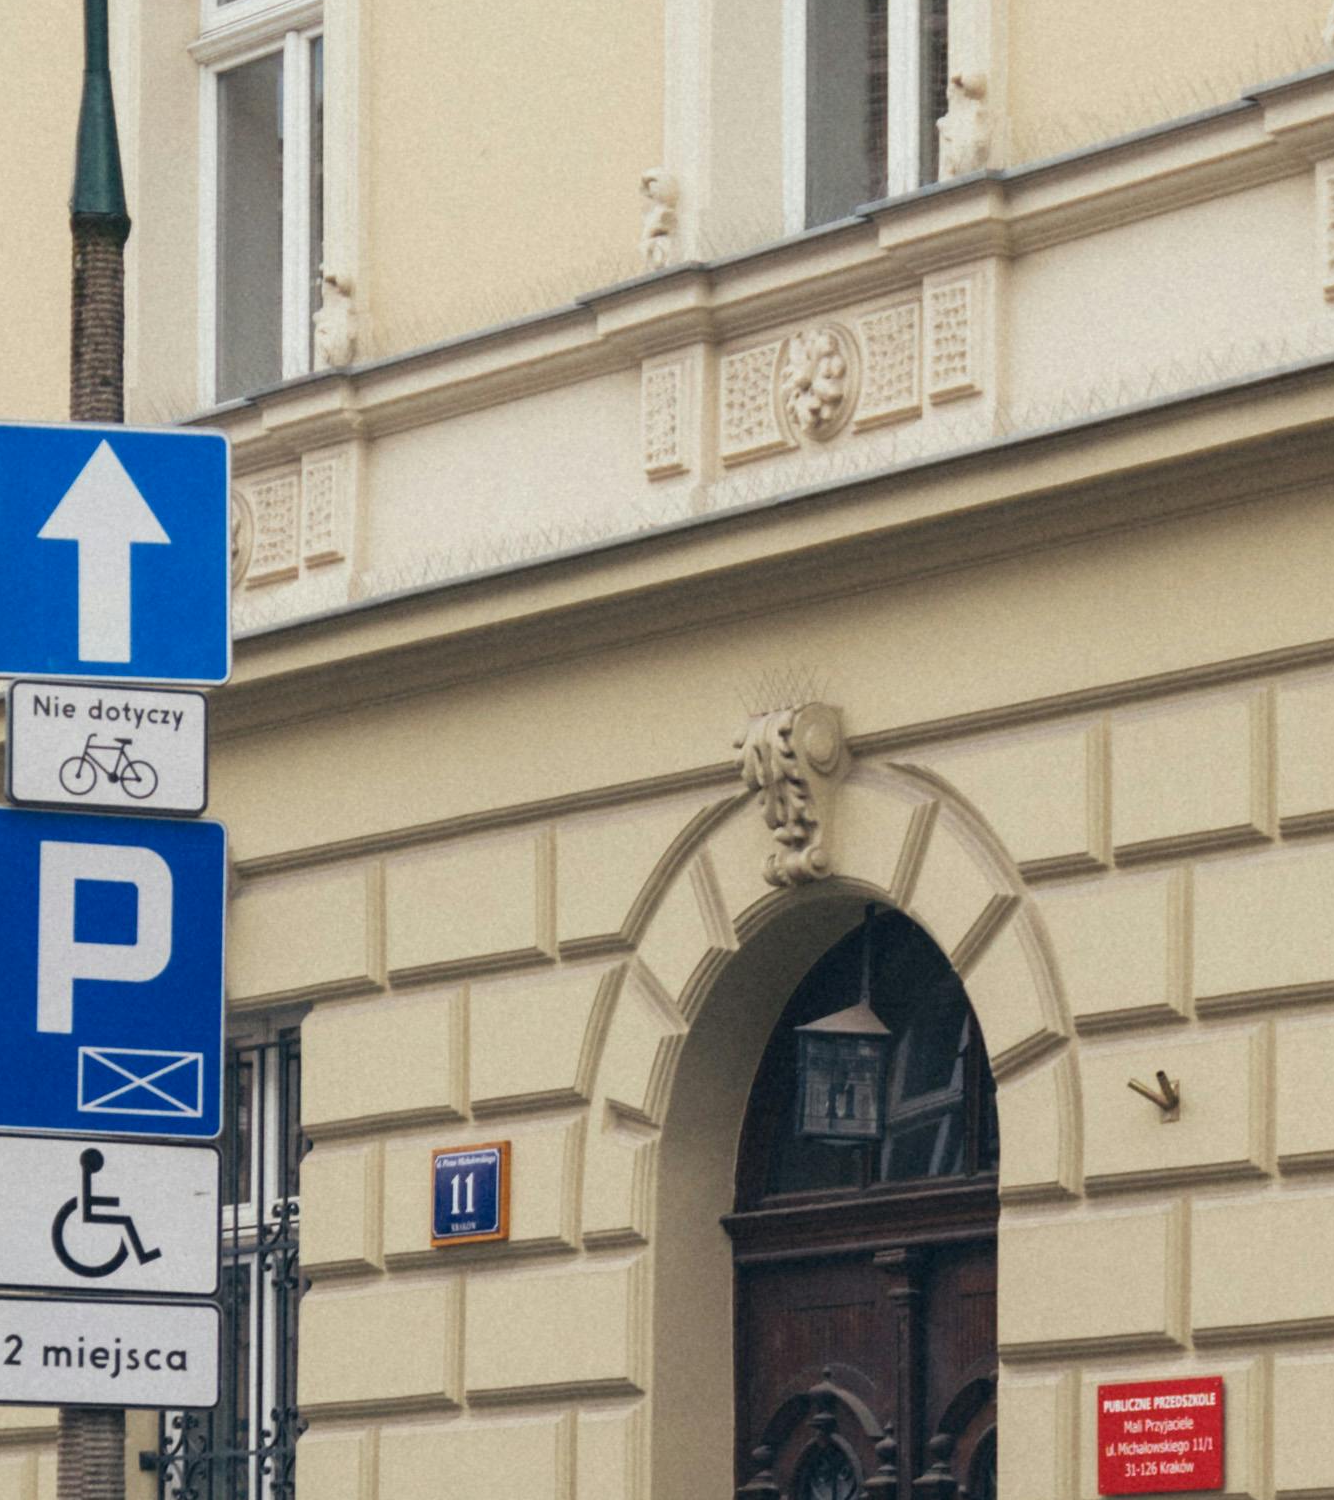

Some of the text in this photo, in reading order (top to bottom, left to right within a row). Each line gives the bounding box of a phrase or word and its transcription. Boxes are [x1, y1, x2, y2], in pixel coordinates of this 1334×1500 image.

[33, 694, 184, 731] Nie dotyczy
[37, 840, 173, 1034] P
[450, 1172, 474, 1215] 11
[3, 1333, 188, 1379] 2 miejsca
[1103, 1392, 1216, 1413] PUBLICZNE PRZEDSZKOLE
[1144, 1416, 1195, 1435] Przyjaciele
[1192, 1436, 1214, 1453] 11/1
[1124, 1458, 1195, 1477] 31-126 Kraków
